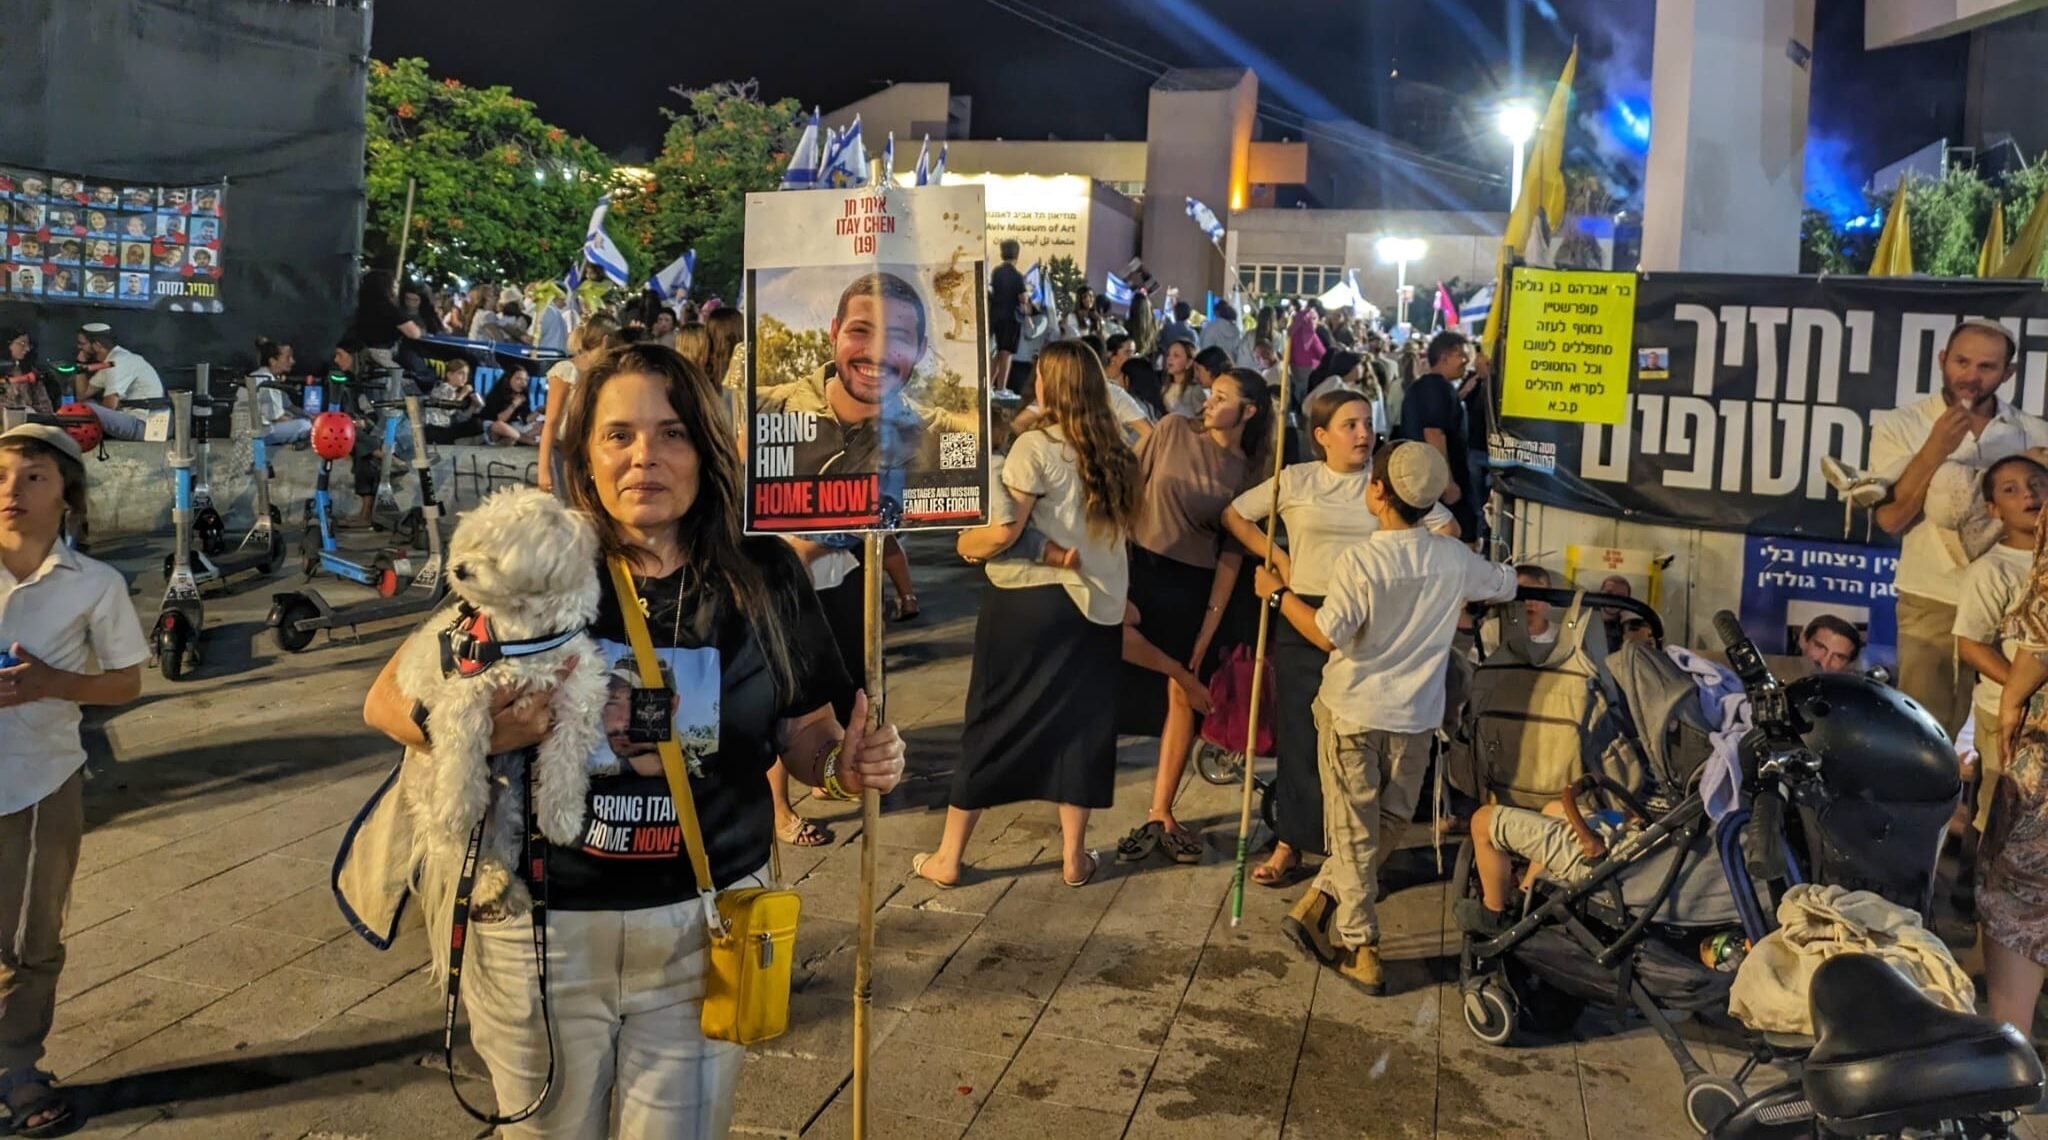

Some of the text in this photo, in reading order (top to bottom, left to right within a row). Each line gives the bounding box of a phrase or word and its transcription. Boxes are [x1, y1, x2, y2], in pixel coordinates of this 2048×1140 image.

[844, 195, 887, 217] איתי חן
[836, 216, 895, 236] ITAY CHEN
[986, 223, 1076, 233] Aviv Museum of Art
[854, 235, 876, 256] (19)
[1549, 281, 1561, 294] בן
[1568, 283, 1608, 296] אברהם
[1543, 301, 1598, 316] קופרשטיין
[1536, 320, 1603, 335] נחטף לעזה
[1523, 338, 1613, 356] מתפללים לשובו
[1674, 303, 1875, 403] יחזיר
[1530, 359, 1602, 375] וכל החטופים
[1525, 378, 1606, 396] לקרוא תהילים
[756, 411, 817, 444] BRING
[1580, 393, 1894, 501] חטופים
[756, 445, 794, 478] HIM
[755, 474, 880, 515] HOME NOW!
[902, 486, 980, 499] HOSTAGES AND MISSING
[903, 496, 980, 515] FAMILIES FORUM
[1760, 545, 1794, 562] בלי
[1802, 550, 1867, 569] ניצחון
[1758, 570, 1816, 588] גולדין
[1822, 576, 1864, 594] הדר
[593, 794, 643, 822] BRING
[584, 818, 681, 852] HOME NOW!
